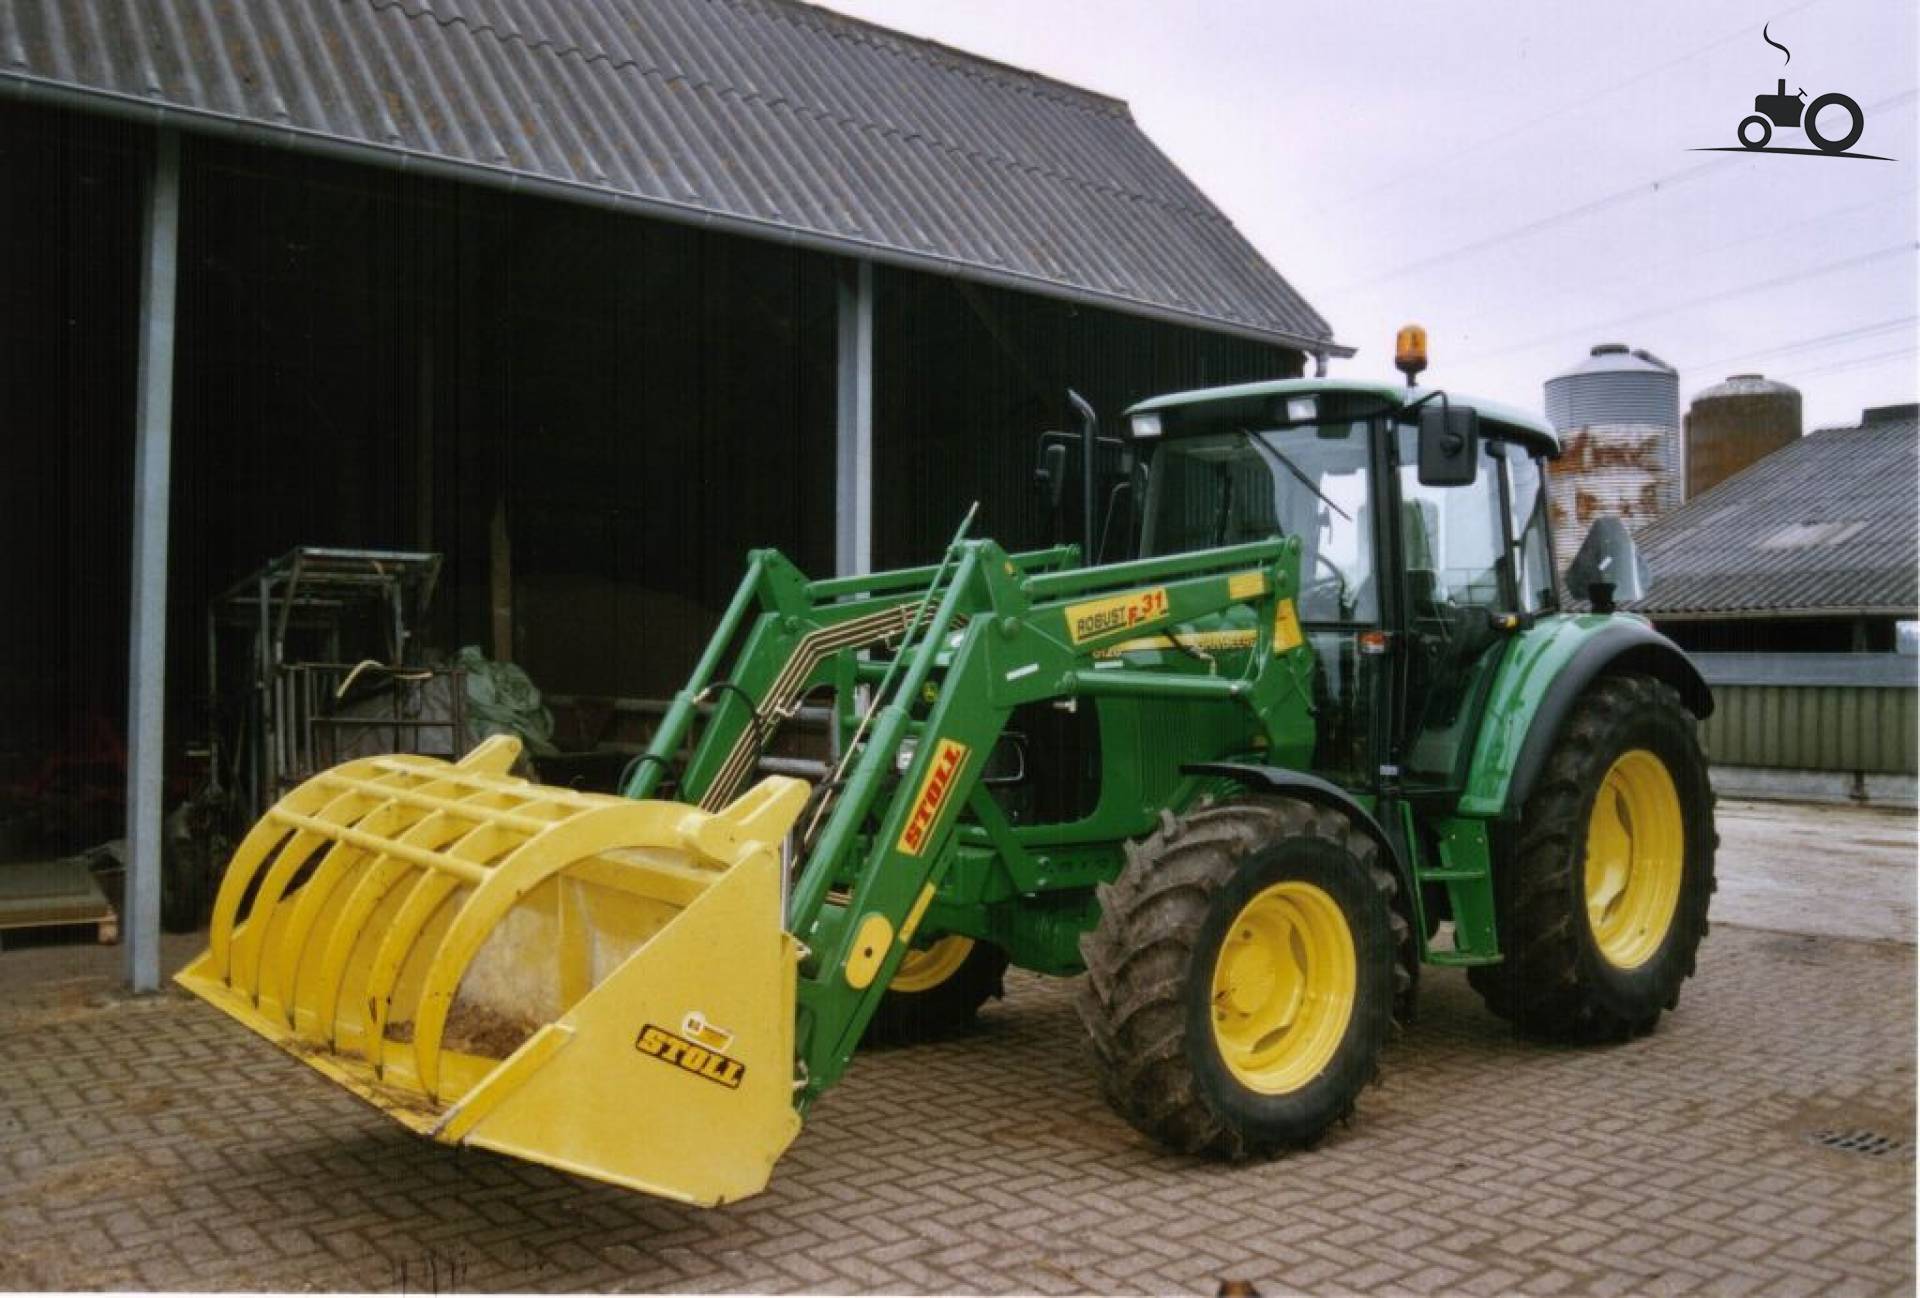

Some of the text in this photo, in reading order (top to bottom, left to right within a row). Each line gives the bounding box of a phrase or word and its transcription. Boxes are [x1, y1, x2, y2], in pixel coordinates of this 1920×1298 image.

[1077, 606, 1126, 635] ROBUST
[903, 747, 961, 850] STOLL
[639, 1029, 742, 1084] STOLL
